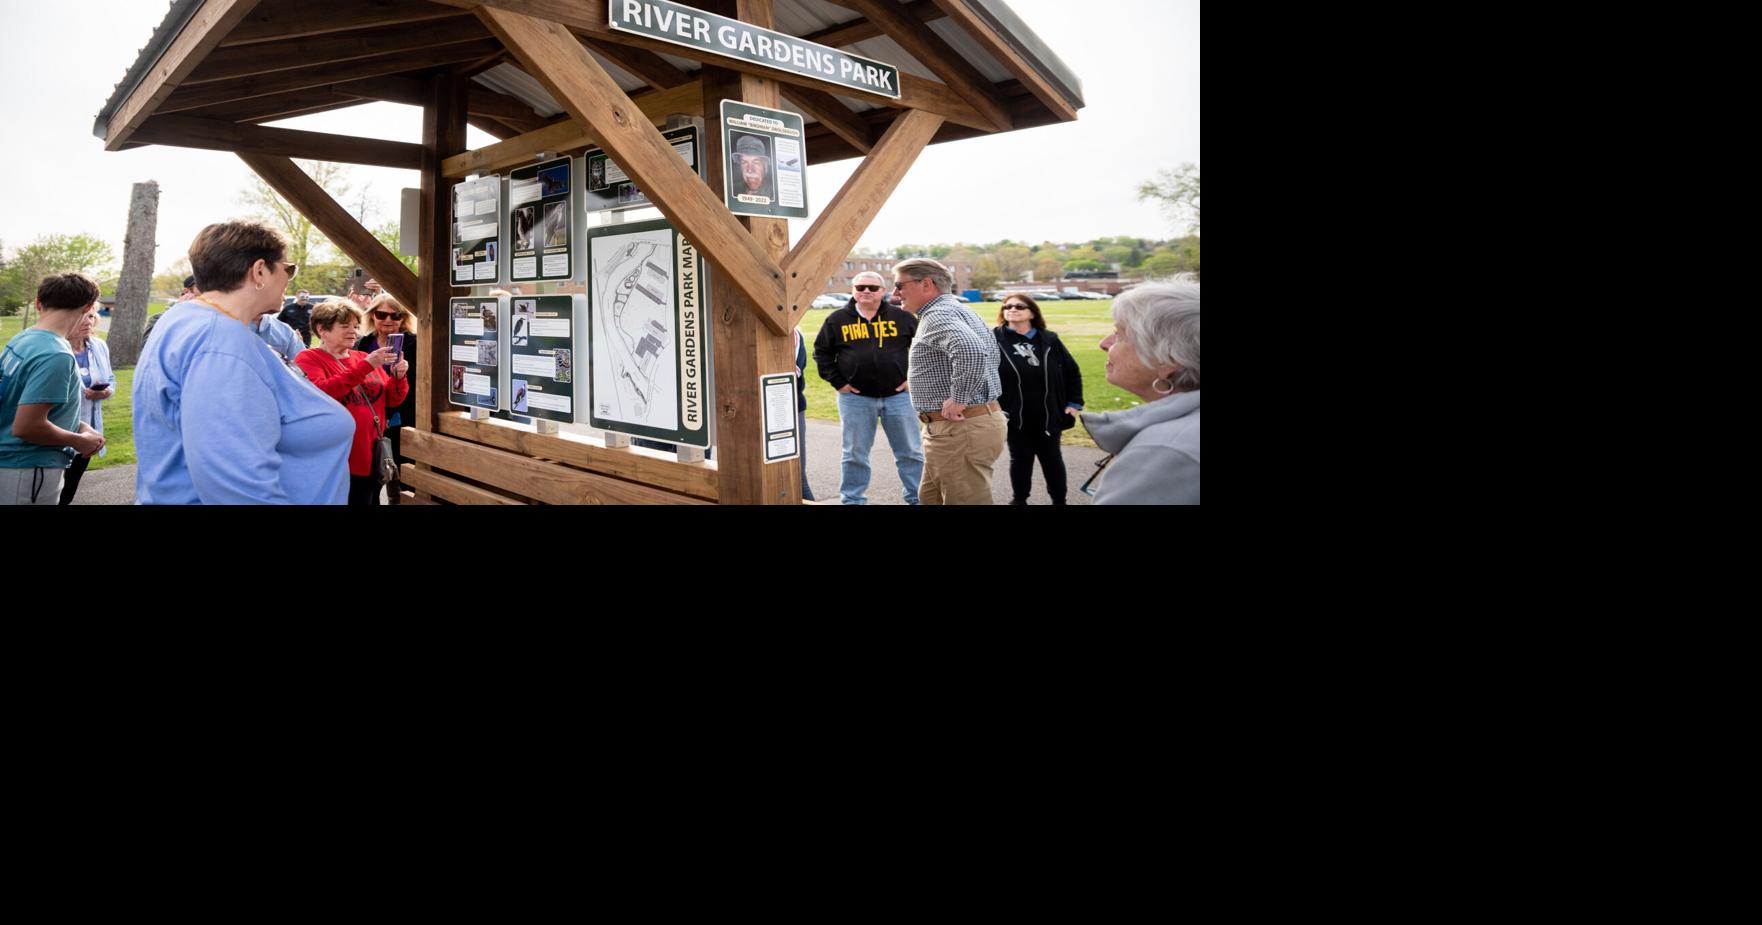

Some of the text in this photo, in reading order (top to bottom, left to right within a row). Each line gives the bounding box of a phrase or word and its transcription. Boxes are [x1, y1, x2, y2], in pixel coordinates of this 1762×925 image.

[623, 0, 893, 90] RIVER GARDENS PARK
[683, 272, 694, 308] PARK
[684, 311, 697, 379] GARDENS
[686, 381, 698, 423] RIVER
